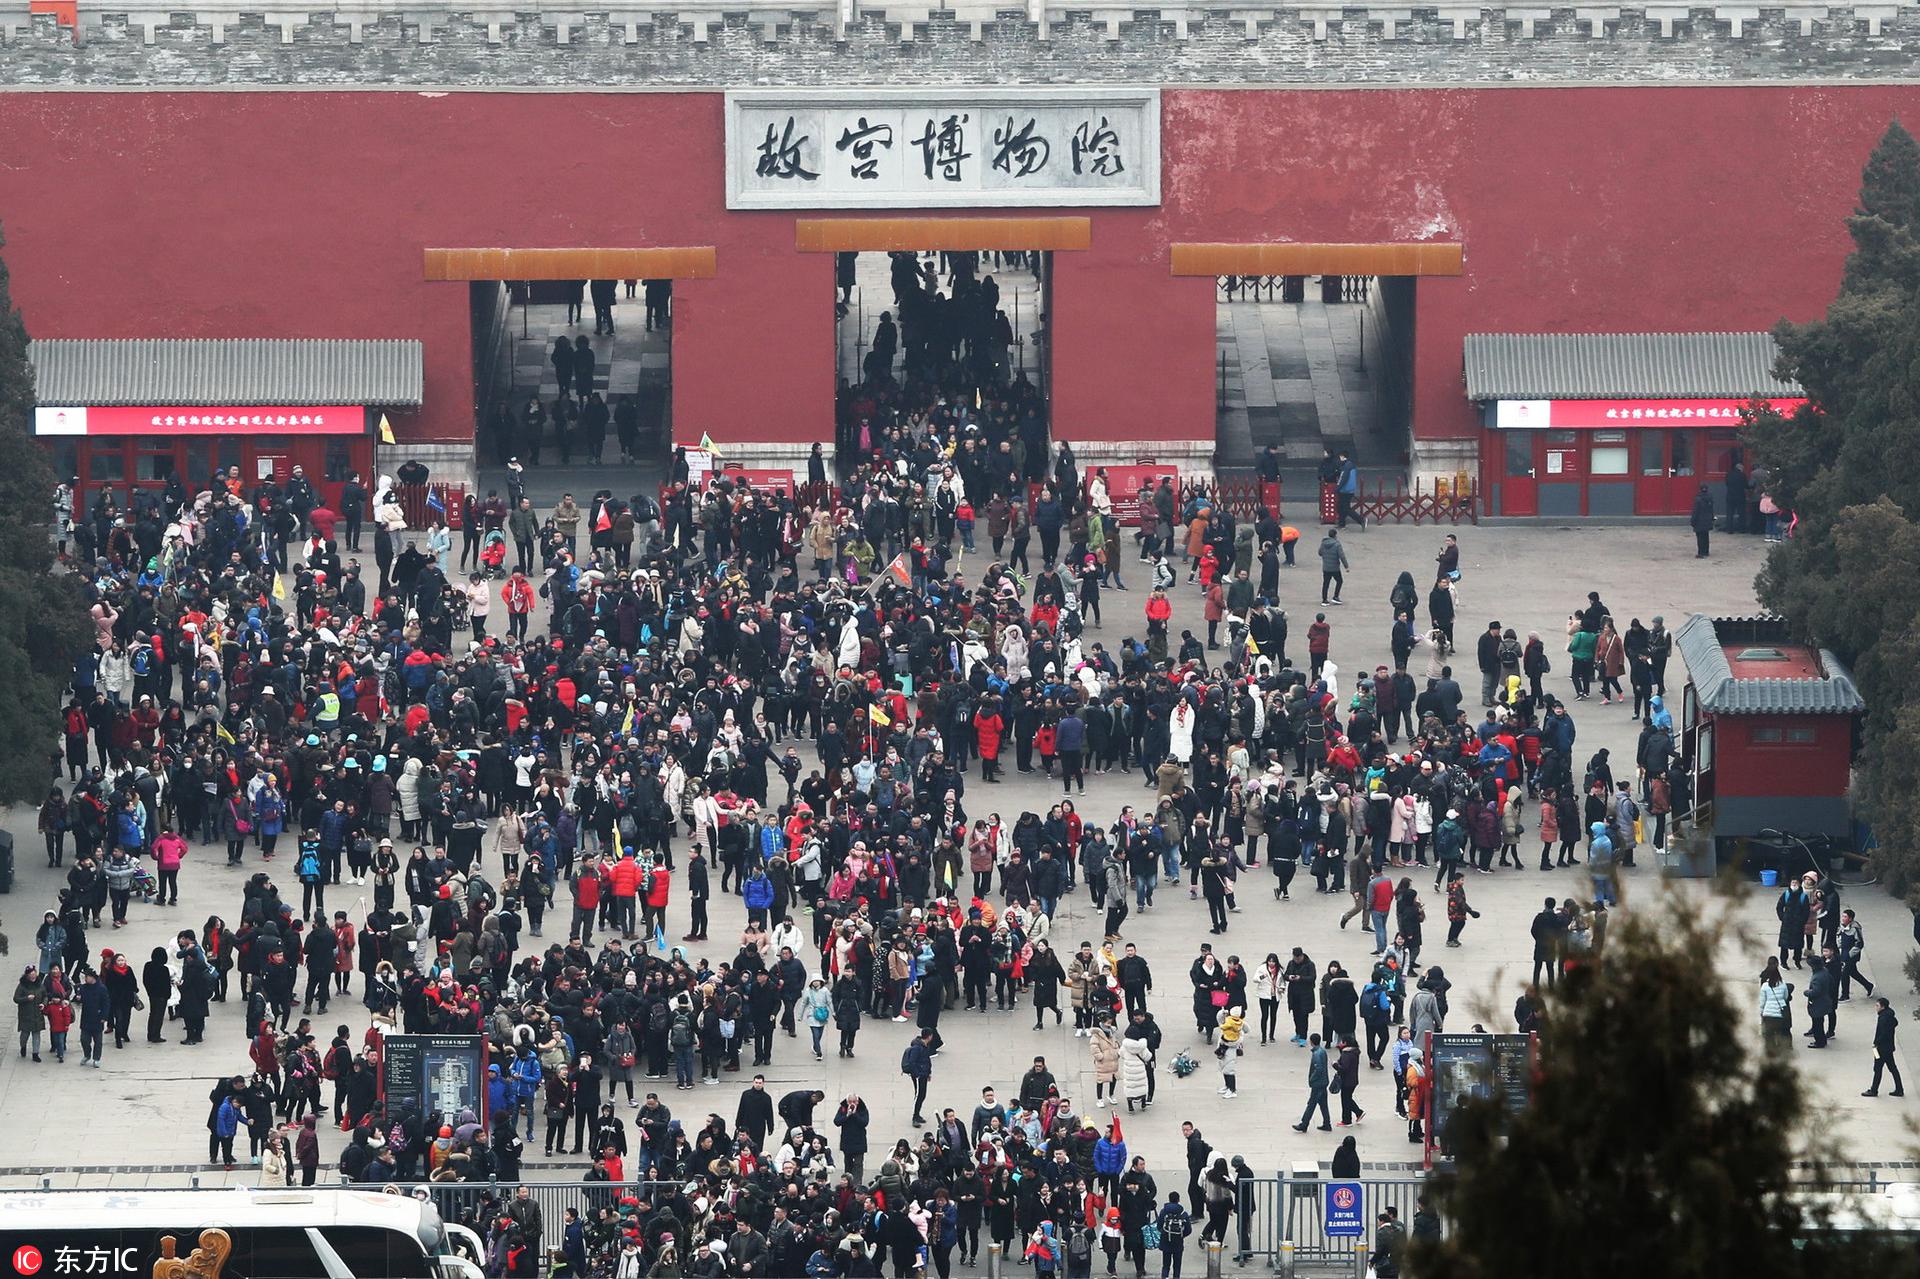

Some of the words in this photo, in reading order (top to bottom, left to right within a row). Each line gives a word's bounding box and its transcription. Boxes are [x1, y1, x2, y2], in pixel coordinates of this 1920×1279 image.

[755, 113, 1125, 182] 故宫博物院
[151, 414, 324, 426] 故宫博物院祝全国观众新春快乐
